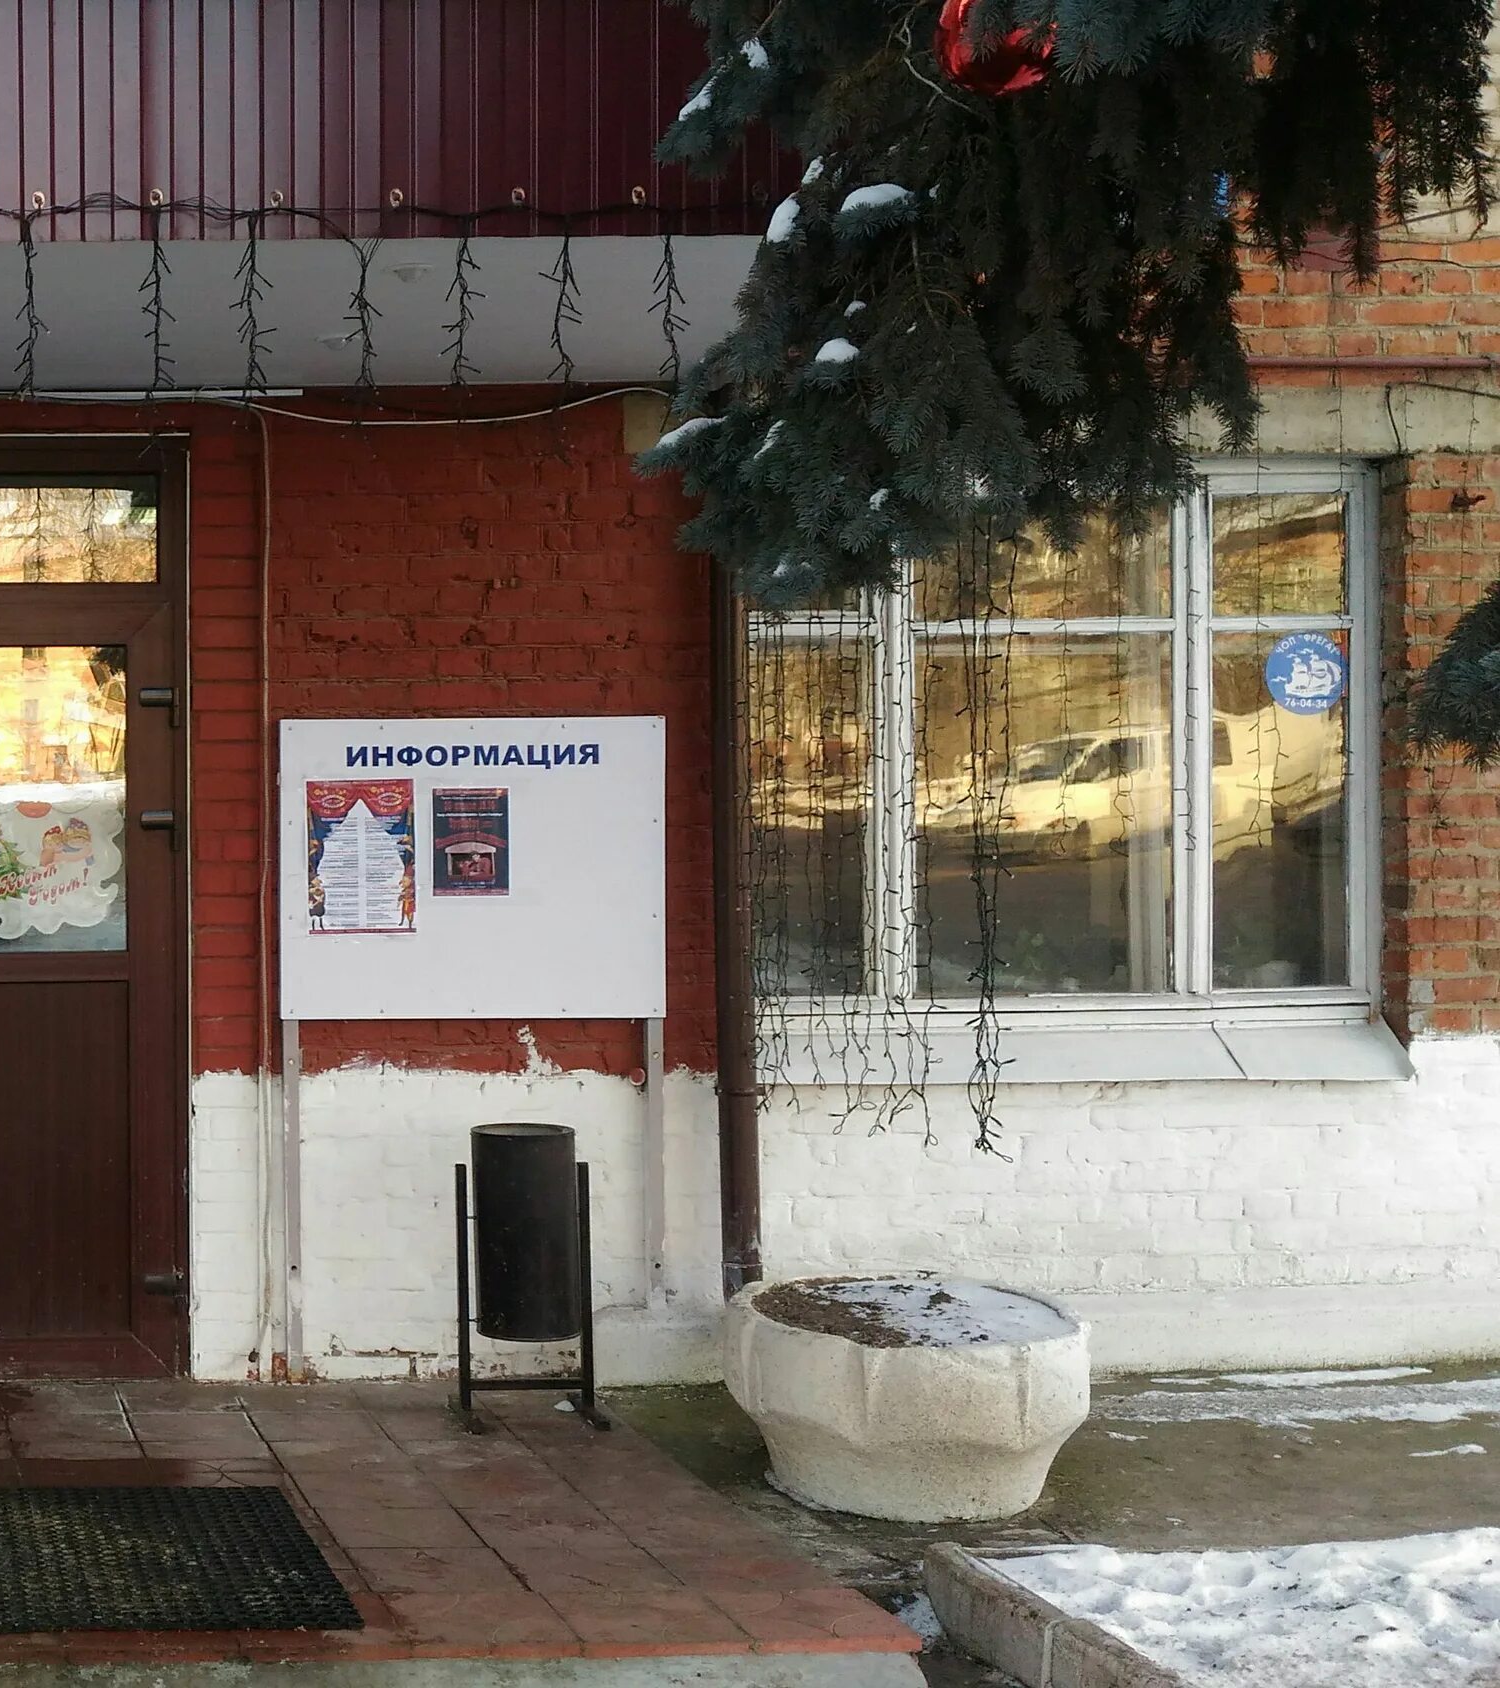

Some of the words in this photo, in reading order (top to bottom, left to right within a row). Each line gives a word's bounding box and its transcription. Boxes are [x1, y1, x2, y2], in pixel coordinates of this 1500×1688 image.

[1275, 637, 1296, 654] ЧОП
[1298, 634, 1341, 656] "ФРЕГАТ"
[1285, 697, 1328, 708] 76-04-34
[345, 743, 600, 769] ИНФОРМАЦИЯ
